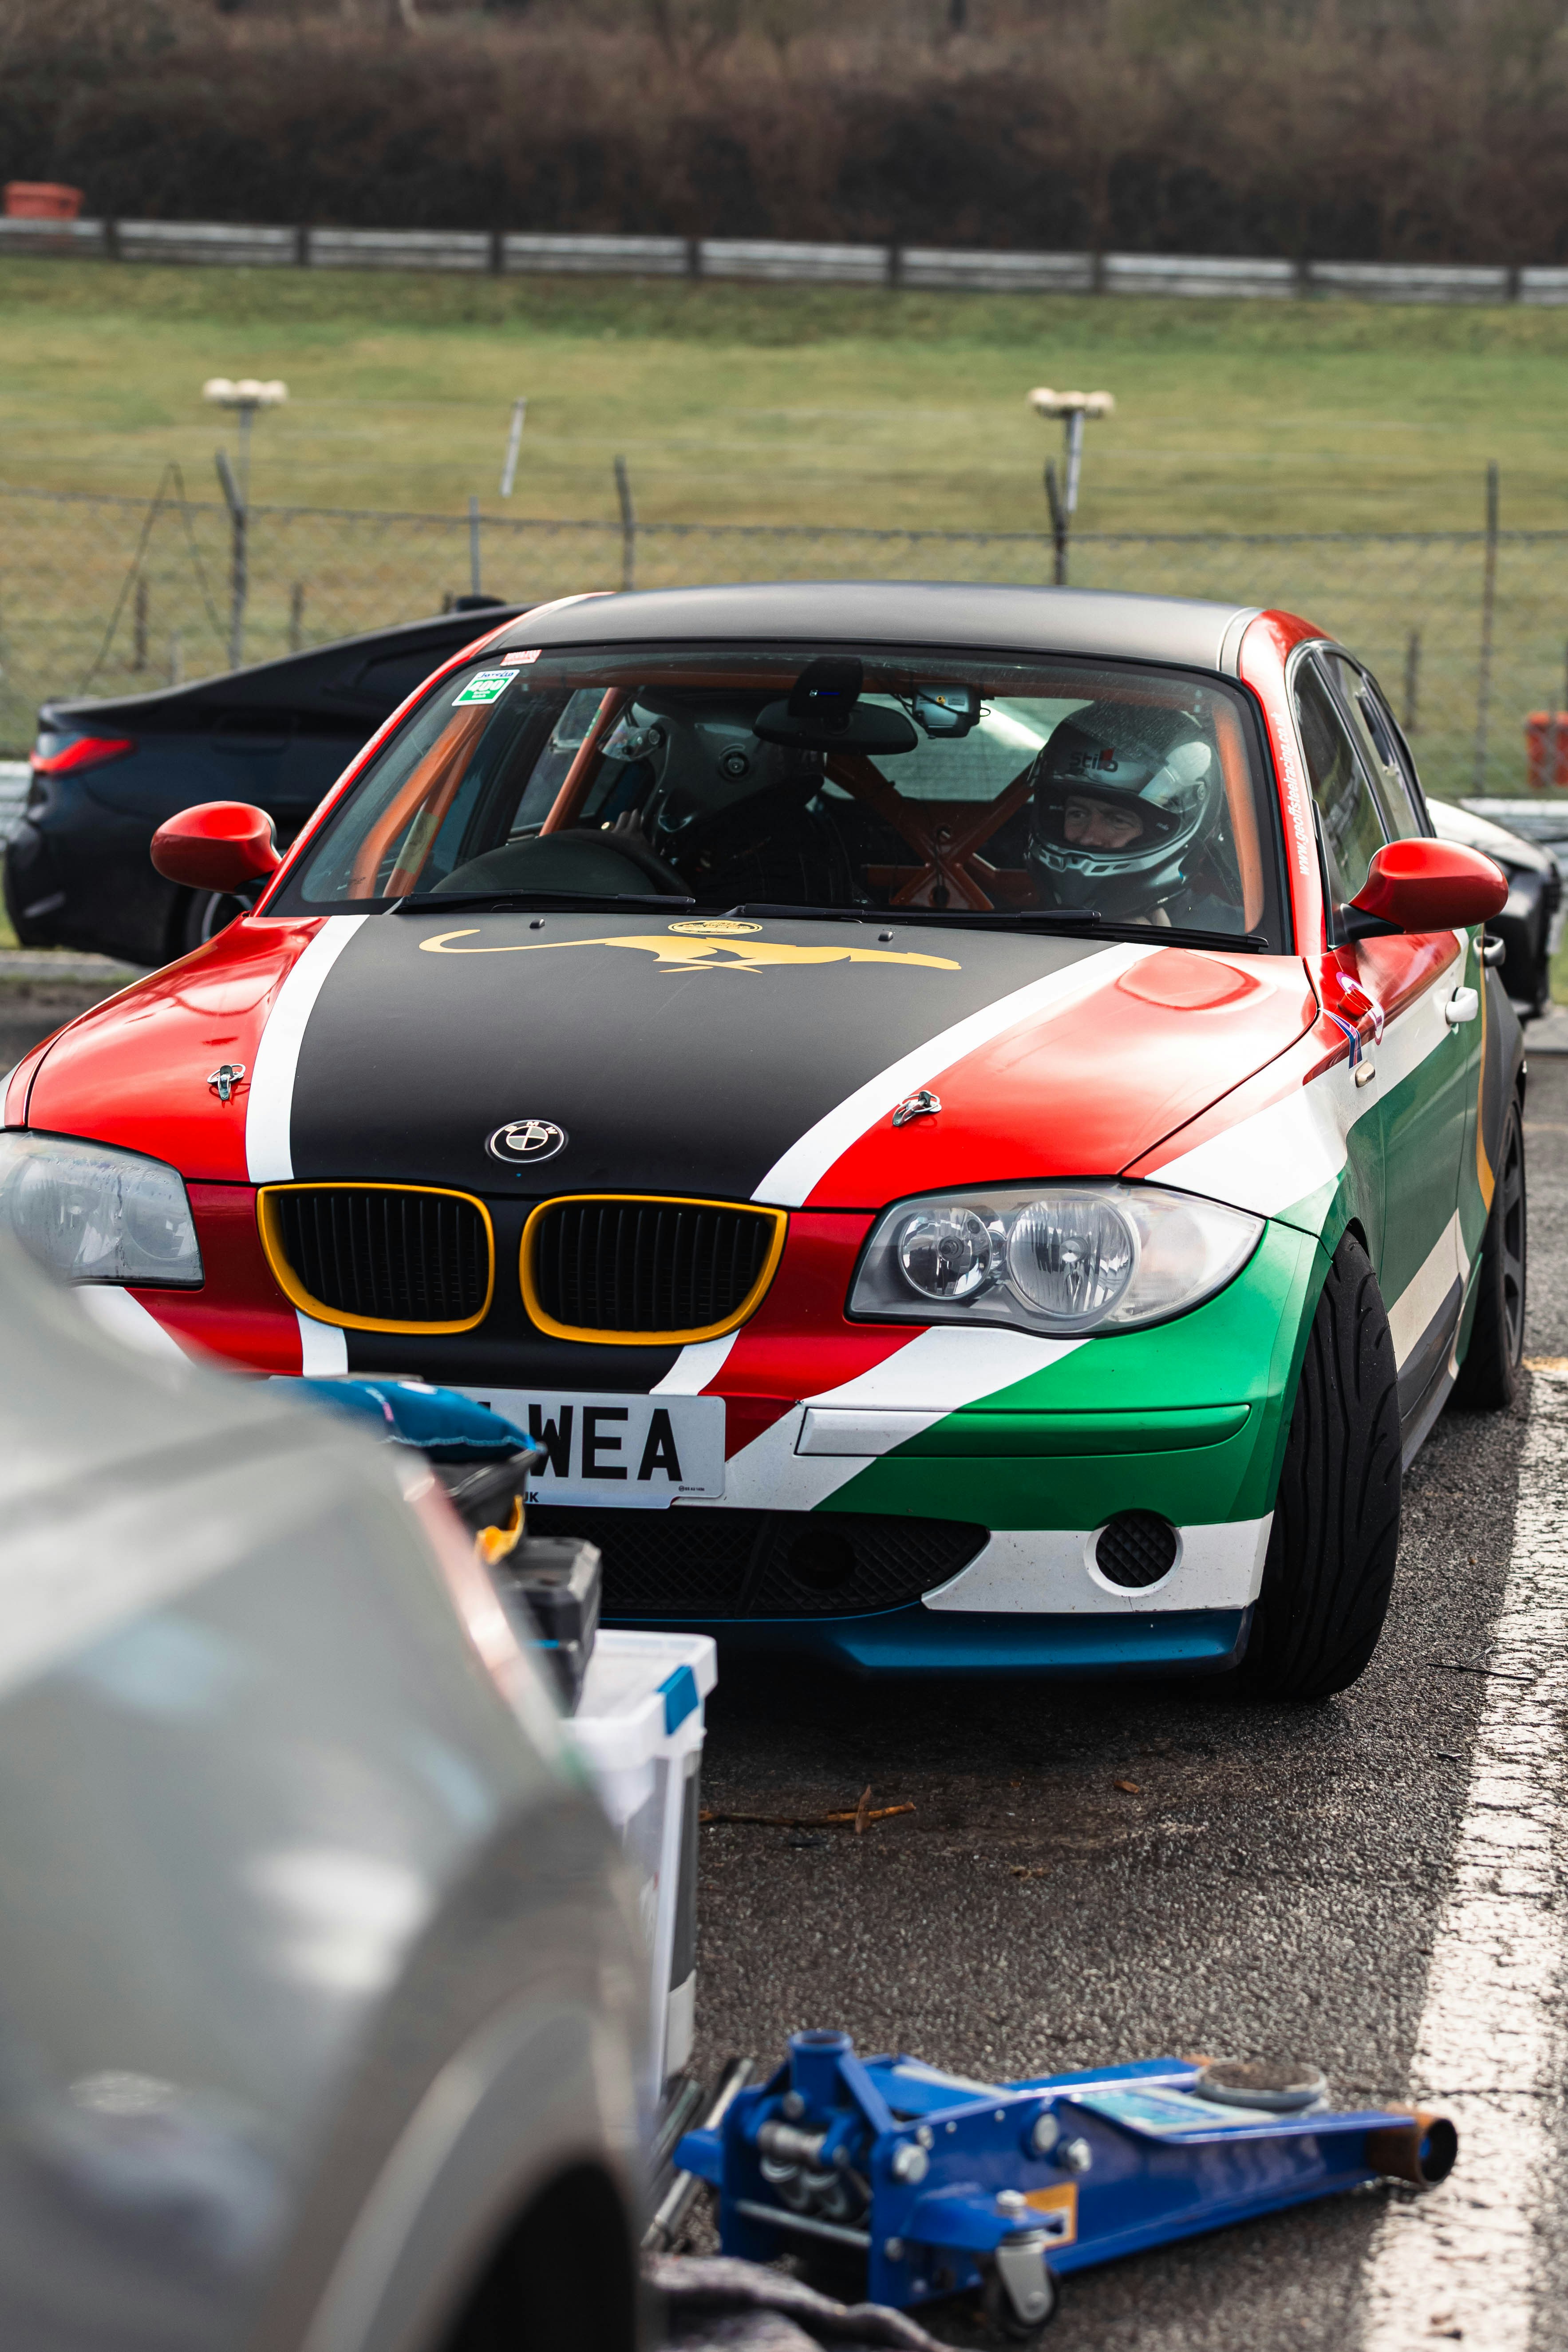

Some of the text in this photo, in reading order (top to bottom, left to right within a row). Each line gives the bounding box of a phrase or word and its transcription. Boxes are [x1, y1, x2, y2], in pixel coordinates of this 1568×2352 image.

[467, 680, 505, 692] 400
[1271, 712, 1310, 876] www.geoffsteelracing.co.uk
[505, 1121, 558, 1134] BMW
[528, 1404, 683, 1481] WEA
